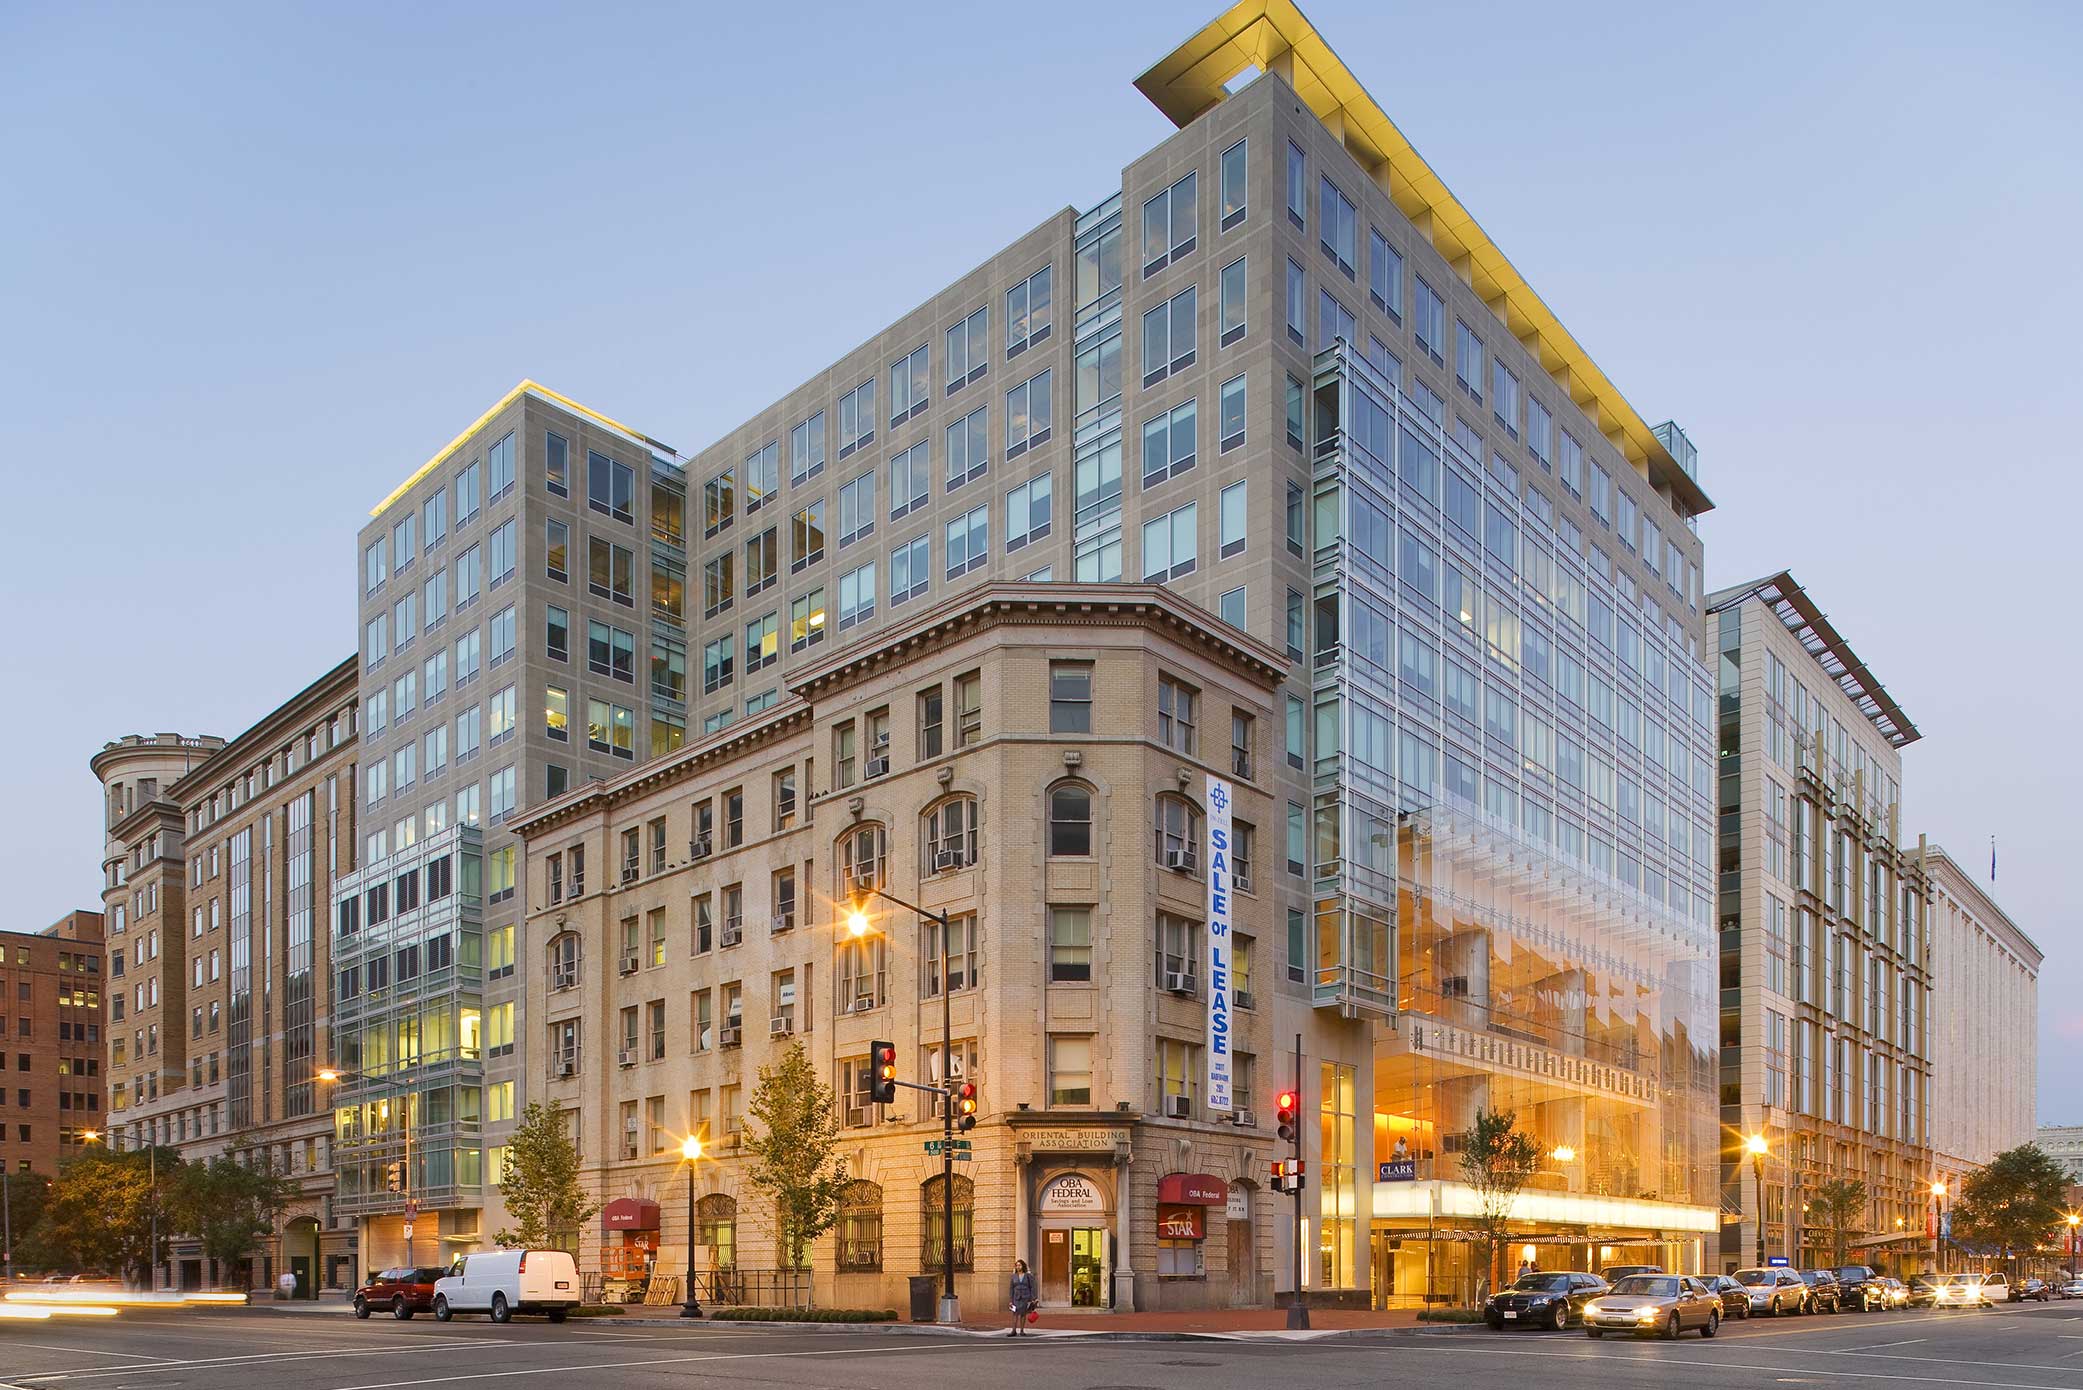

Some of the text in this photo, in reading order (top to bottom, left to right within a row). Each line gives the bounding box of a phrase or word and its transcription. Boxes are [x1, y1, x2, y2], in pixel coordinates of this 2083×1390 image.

[1211, 829, 1228, 915] SALE
[1211, 921, 1228, 937] or
[1212, 947, 1229, 1055] LEASE
[1022, 1131, 1125, 1140] ORIENTAL BUILDING
[1381, 1165, 1412, 1175] CLARK
[1060, 1178, 1082, 1188] OBA
[1052, 1189, 1092, 1198] FEDERAL
[1189, 1190, 1220, 1199] OBA Federal
[1167, 1221, 1195, 1236] STAR
[634, 1240, 649, 1250] STAR
